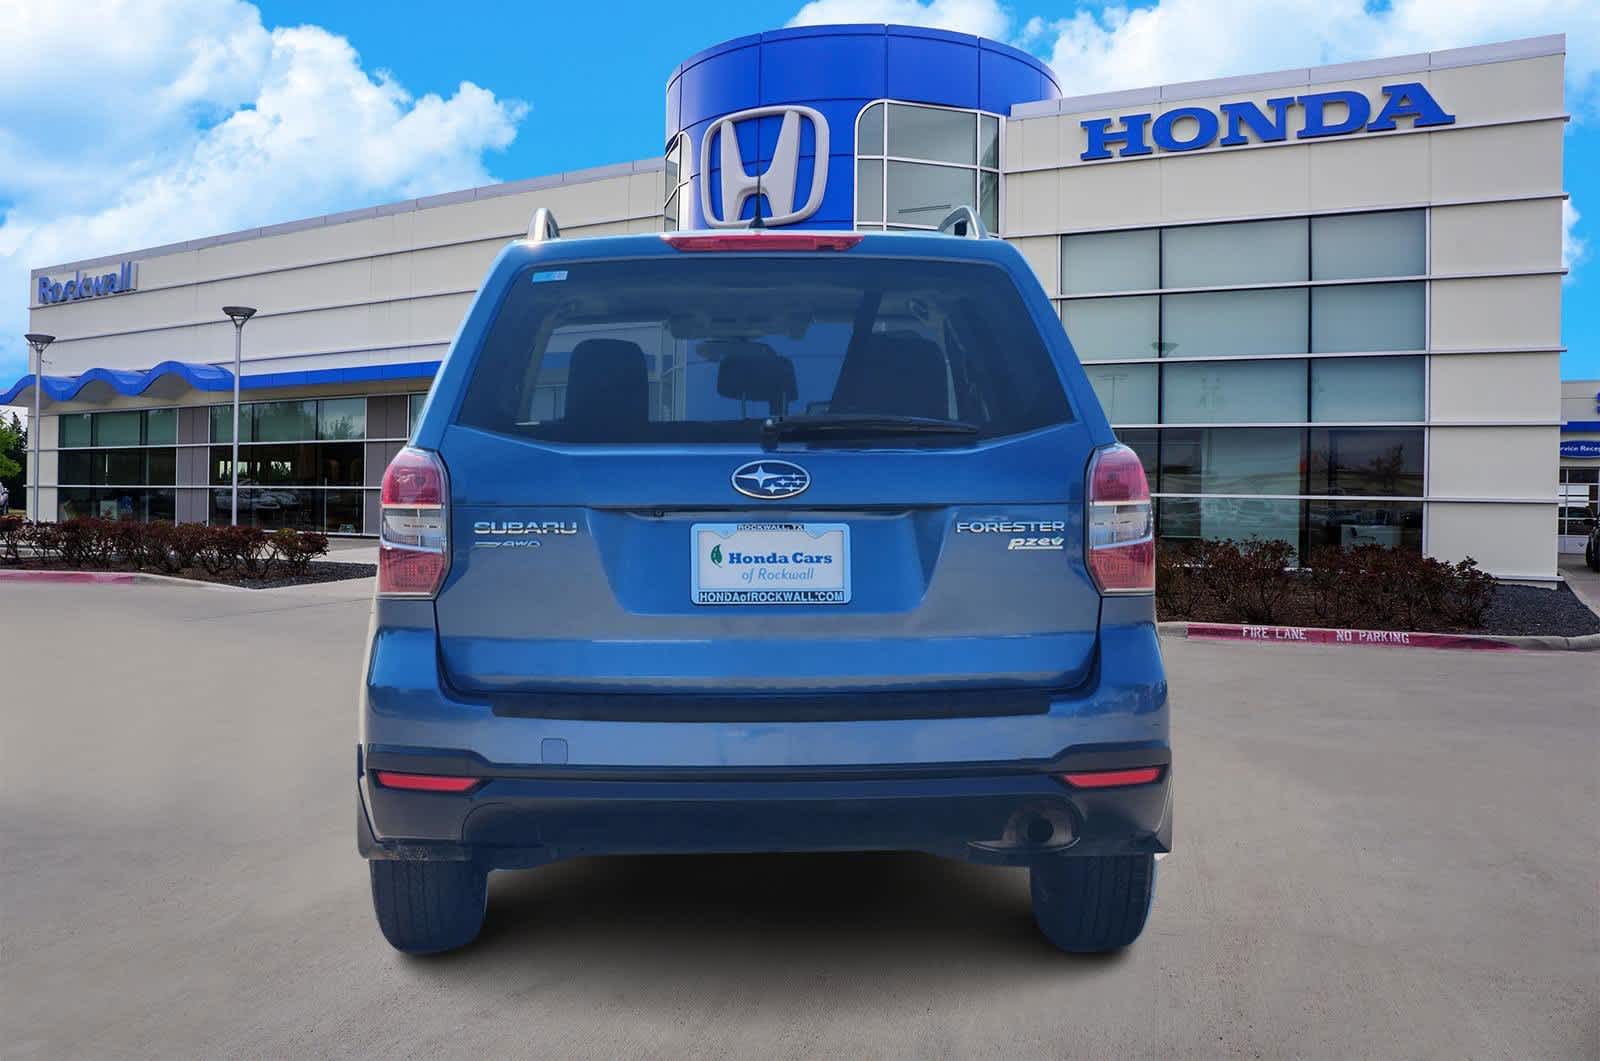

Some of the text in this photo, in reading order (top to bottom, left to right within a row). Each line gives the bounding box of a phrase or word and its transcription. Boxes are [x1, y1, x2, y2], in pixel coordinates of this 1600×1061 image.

[1080, 82, 1456, 161] HONDA
[38, 261, 134, 304] Rockwall
[474, 521, 577, 534] SUBARU
[957, 521, 1065, 533] FORESTER
[728, 552, 832, 564] Honda Cars
[741, 567, 814, 583] of Rockwall
[1242, 626, 1307, 640] FIRE LANE
[1336, 630, 1410, 644] NO PARKING
